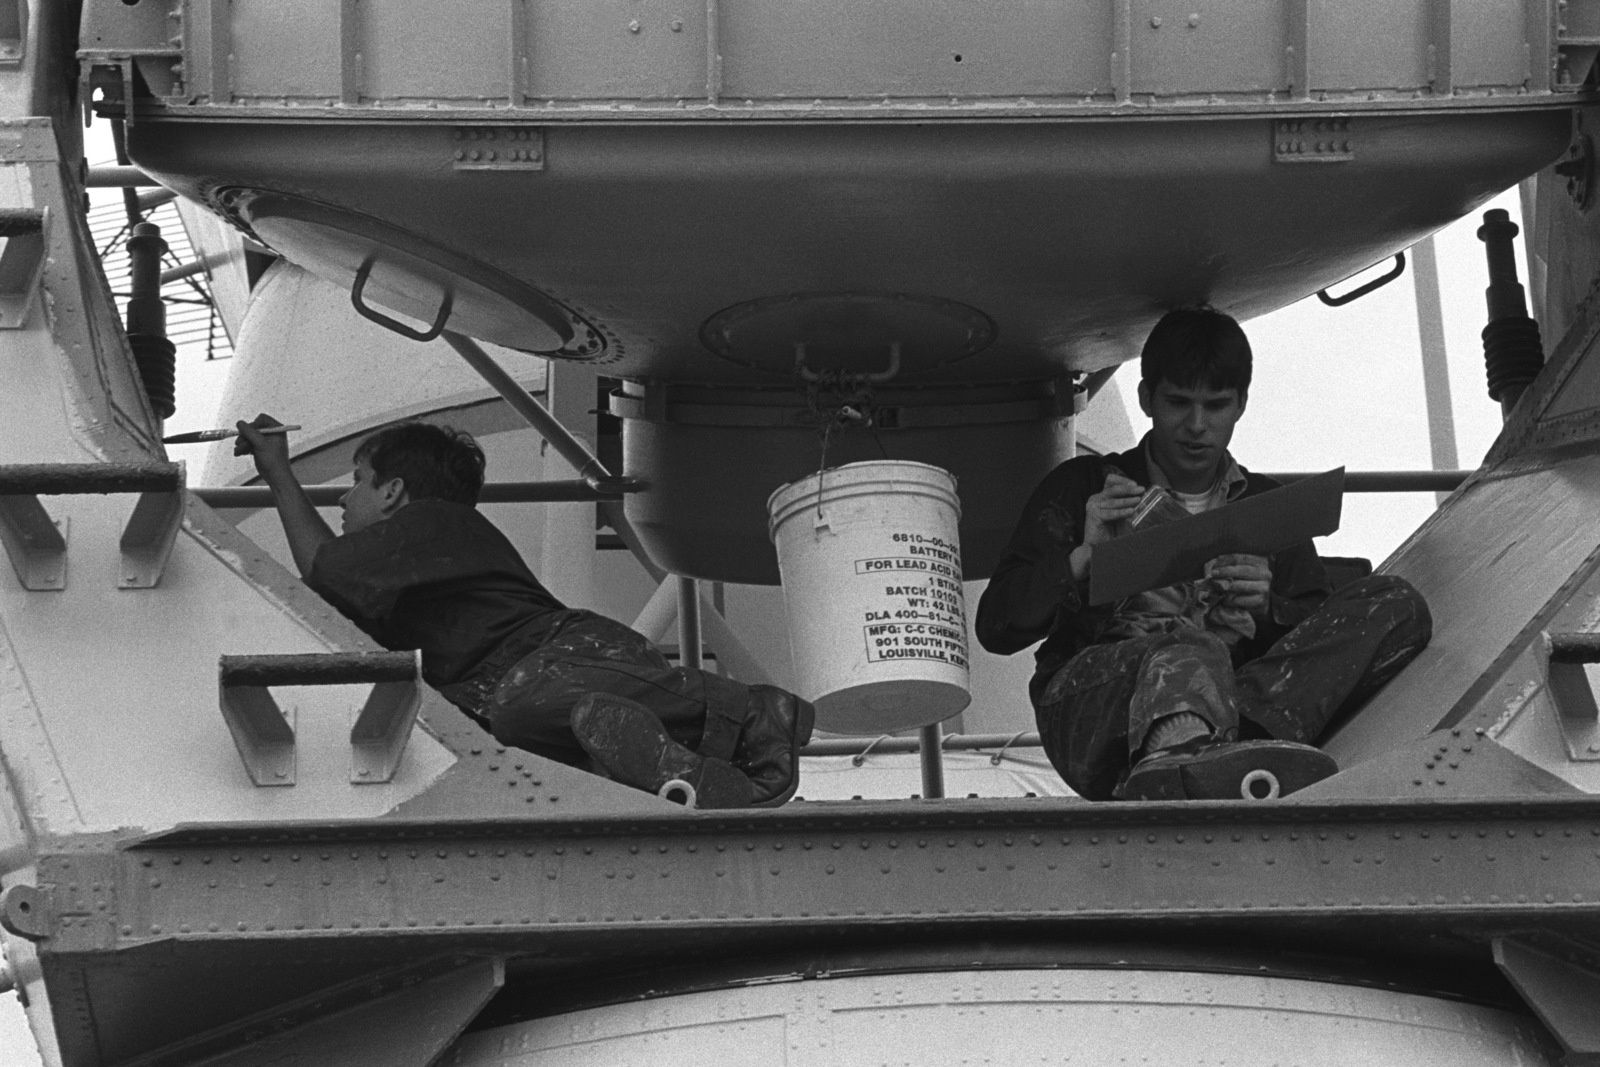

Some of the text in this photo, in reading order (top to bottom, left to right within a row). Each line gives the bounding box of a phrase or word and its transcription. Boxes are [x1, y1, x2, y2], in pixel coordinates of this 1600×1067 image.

[909, 545, 952, 563] BATTERY
[865, 560, 893, 570] FOR
[896, 560, 927, 570] LEAD
[930, 562, 951, 576] ACID
[928, 576, 934, 586] 1
[886, 586, 928, 596] BATCH
[907, 598, 930, 608] WT:
[932, 601, 945, 611] 42
[865, 610, 891, 621] DLA
[868, 624, 901, 636] MFG:
[904, 624, 925, 634] C-C
[875, 637, 899, 647] 901
[904, 636, 942, 648] SOUTH
[878, 648, 948, 664] LOUISVILLE,
